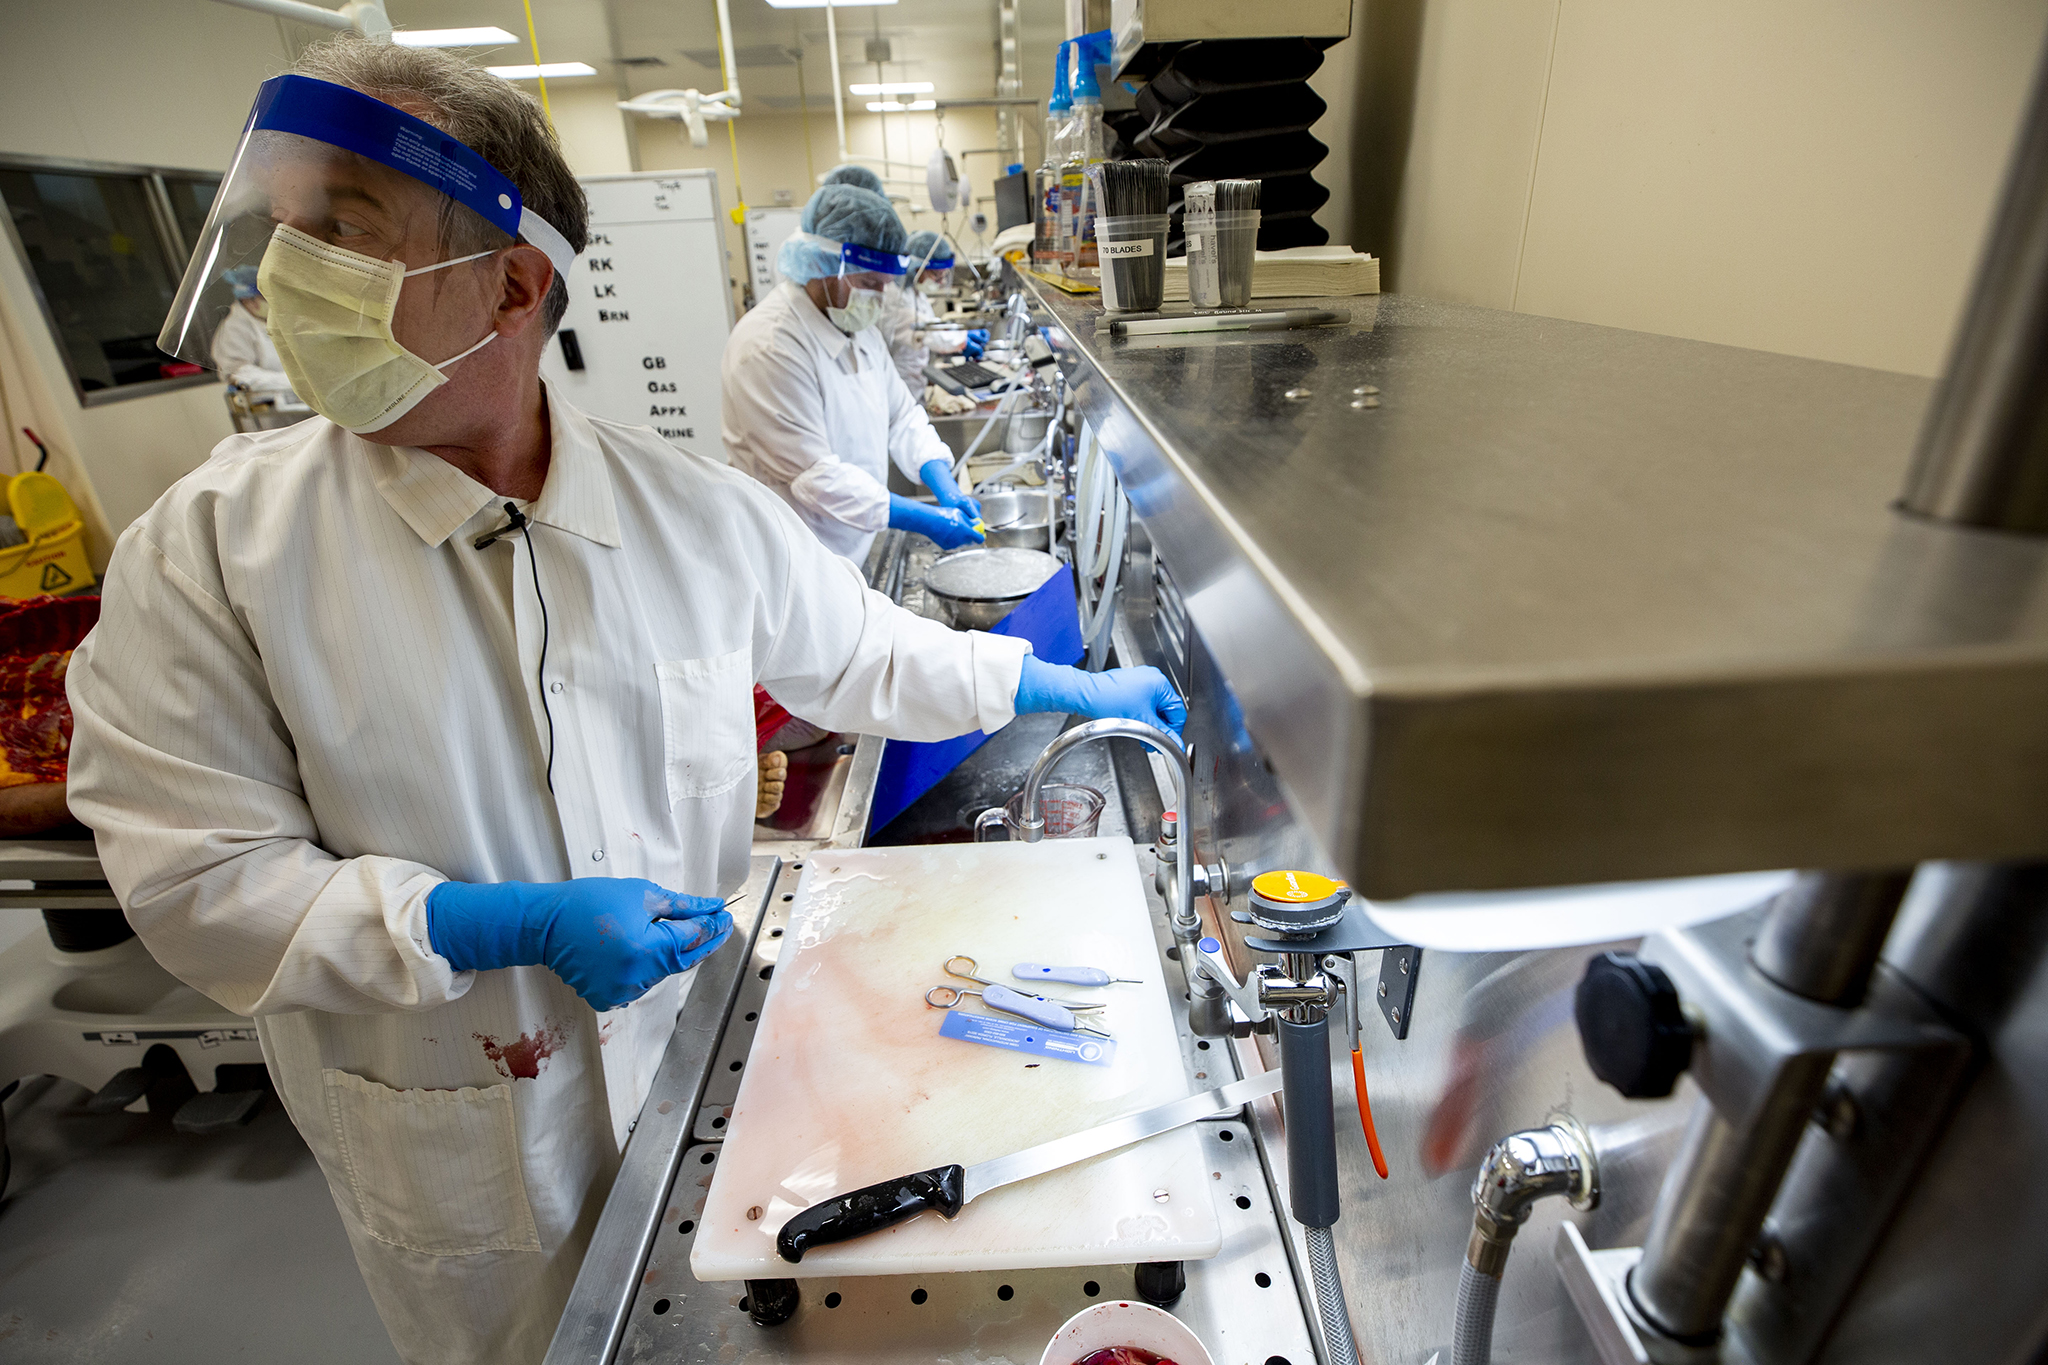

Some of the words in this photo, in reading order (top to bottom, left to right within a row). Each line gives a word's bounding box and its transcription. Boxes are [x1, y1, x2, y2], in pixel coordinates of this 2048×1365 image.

[391, 152, 405, 160] open
[395, 141, 407, 150] This
[407, 149, 424, 159] shield
[421, 145, 441, 157] against
[455, 179, 473, 191] against
[1110, 245, 1142, 253] BLADES
[589, 258, 613, 271] RK
[594, 284, 616, 297] LK
[642, 356, 666, 370] GB
[385, 394, 405, 412] MEDLINE
